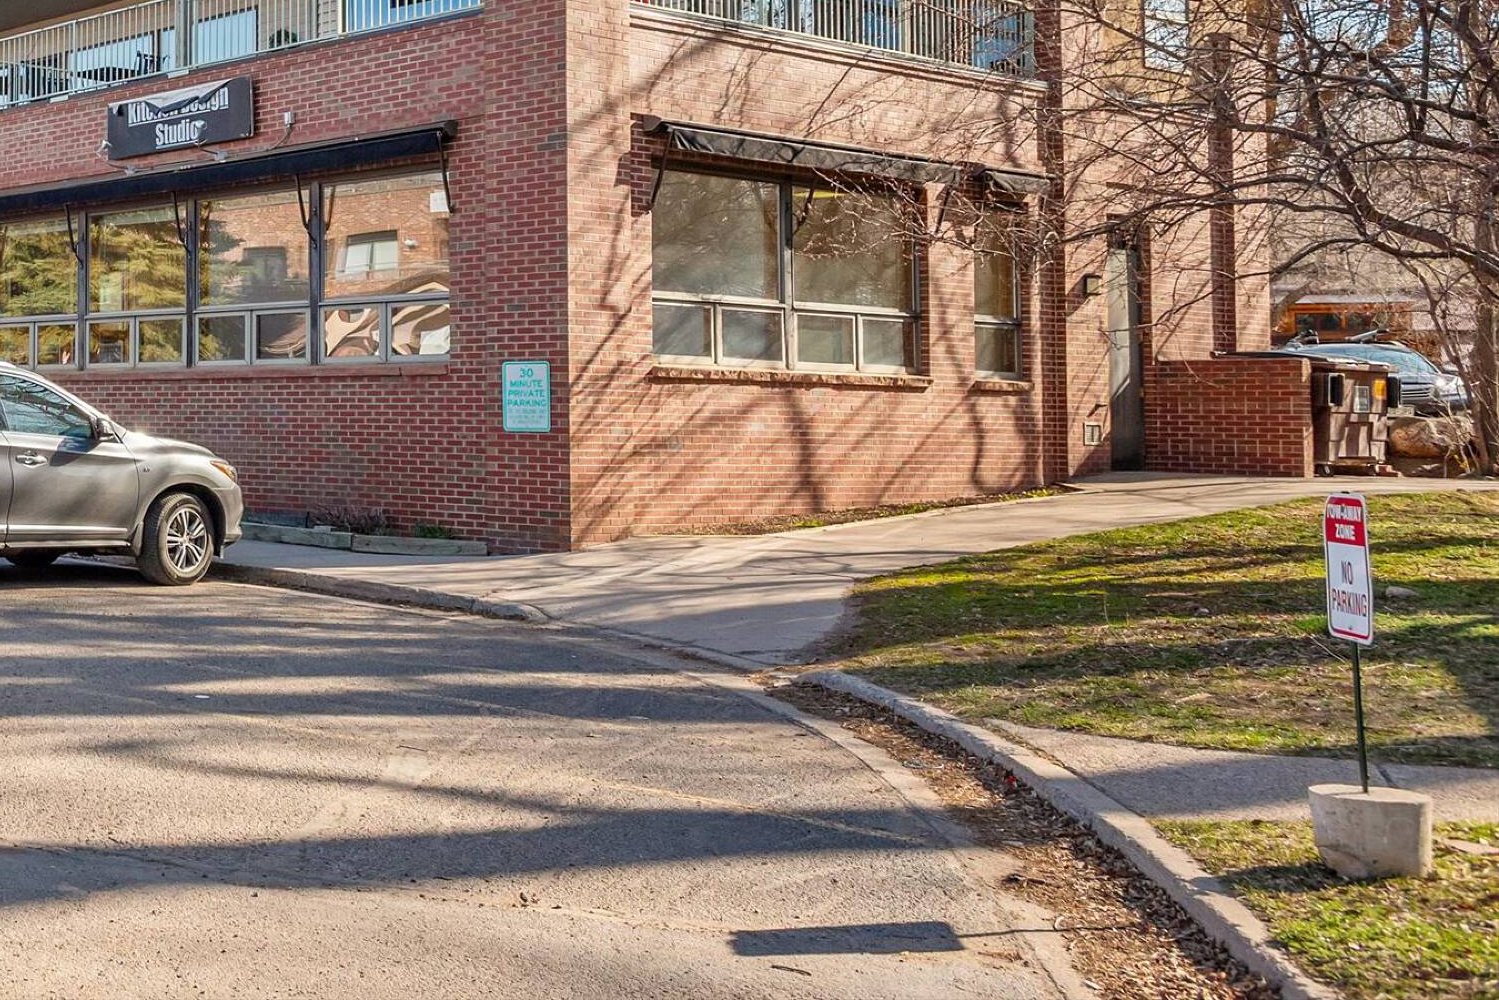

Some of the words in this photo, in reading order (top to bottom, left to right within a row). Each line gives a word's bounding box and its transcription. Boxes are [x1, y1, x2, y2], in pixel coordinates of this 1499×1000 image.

[128, 102, 179, 124] Kitc
[155, 117, 199, 146] Studio
[520, 368, 534, 378] 30
[510, 380, 543, 388] MINUTE
[508, 389, 545, 398] PRIVATE
[508, 399, 547, 407] PARKING
[1335, 524, 1356, 540] ZONE
[1341, 560, 1353, 585] NO
[1332, 588, 1367, 617] PARKING
